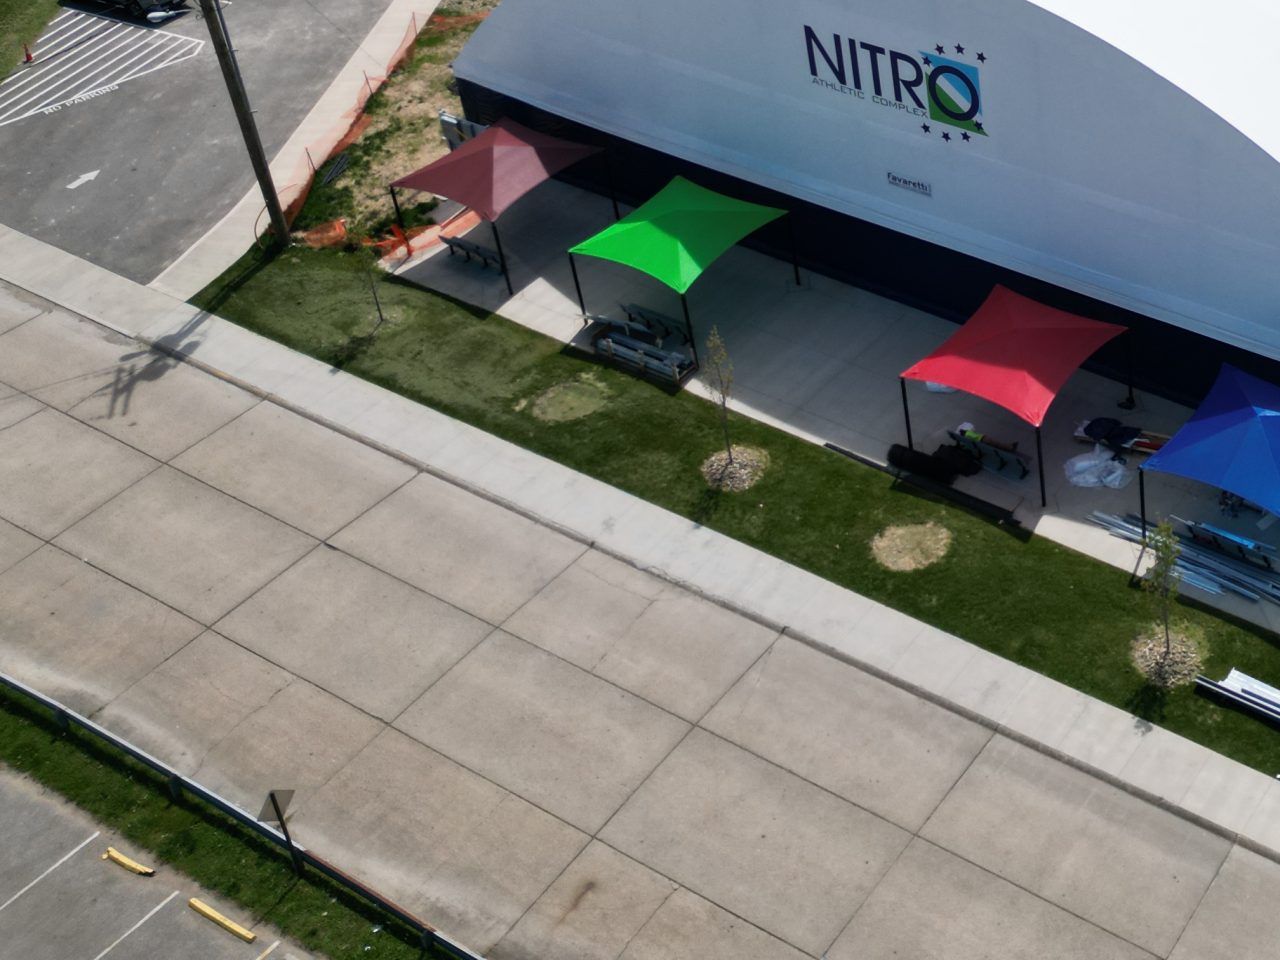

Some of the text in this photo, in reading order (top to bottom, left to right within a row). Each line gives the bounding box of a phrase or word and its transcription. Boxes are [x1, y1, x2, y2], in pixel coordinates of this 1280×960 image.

[803, 24, 979, 121] NITRO
[43, 84, 119, 114] NO PARKING
[812, 77, 928, 119] ATHLETIC COMPLEX
